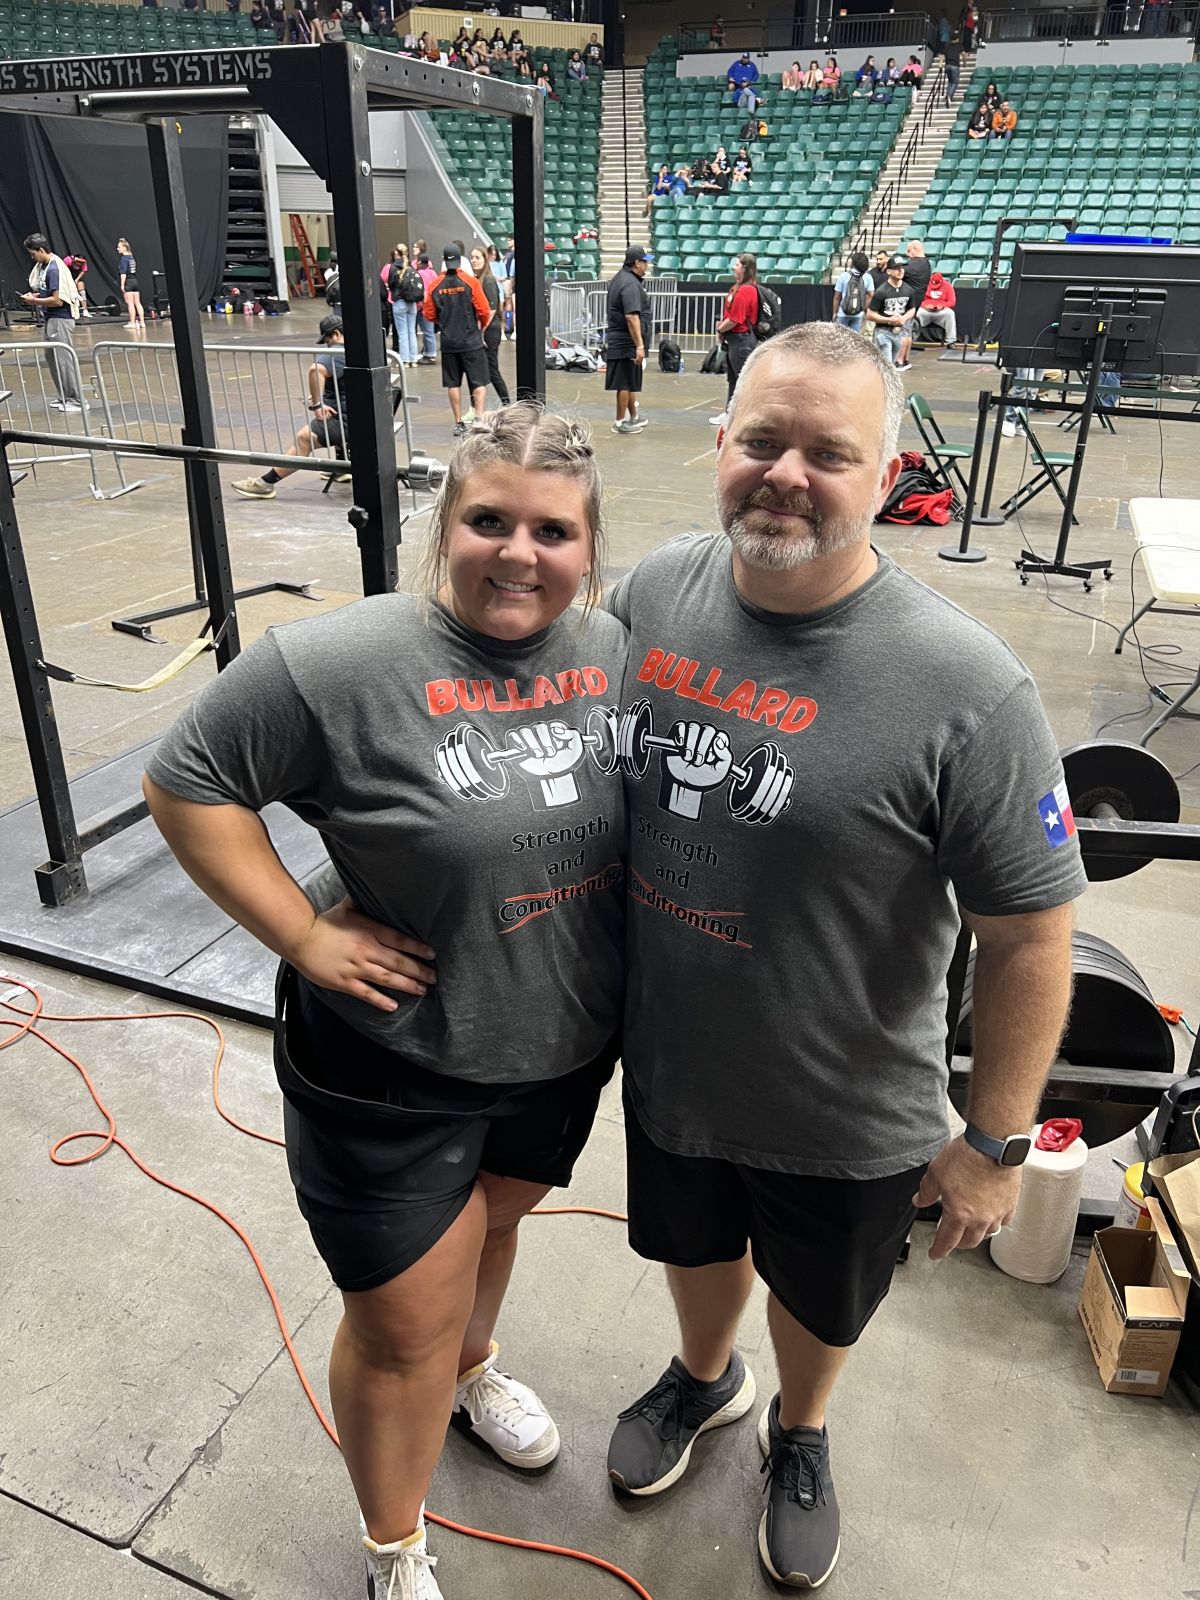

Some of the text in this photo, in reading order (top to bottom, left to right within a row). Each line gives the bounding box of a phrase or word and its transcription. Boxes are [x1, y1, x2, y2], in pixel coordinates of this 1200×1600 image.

[0, 52, 272, 91] S STRENGTH SYSTEMS
[424, 665, 609, 716] BULLARD
[638, 648, 817, 732] BULLARD
[512, 816, 609, 852] Strength
[637, 816, 719, 867] Strength
[546, 850, 585, 876] and
[654, 862, 690, 890] and
[499, 868, 623, 921] Conditioning
[632, 879, 739, 942] onditioning
